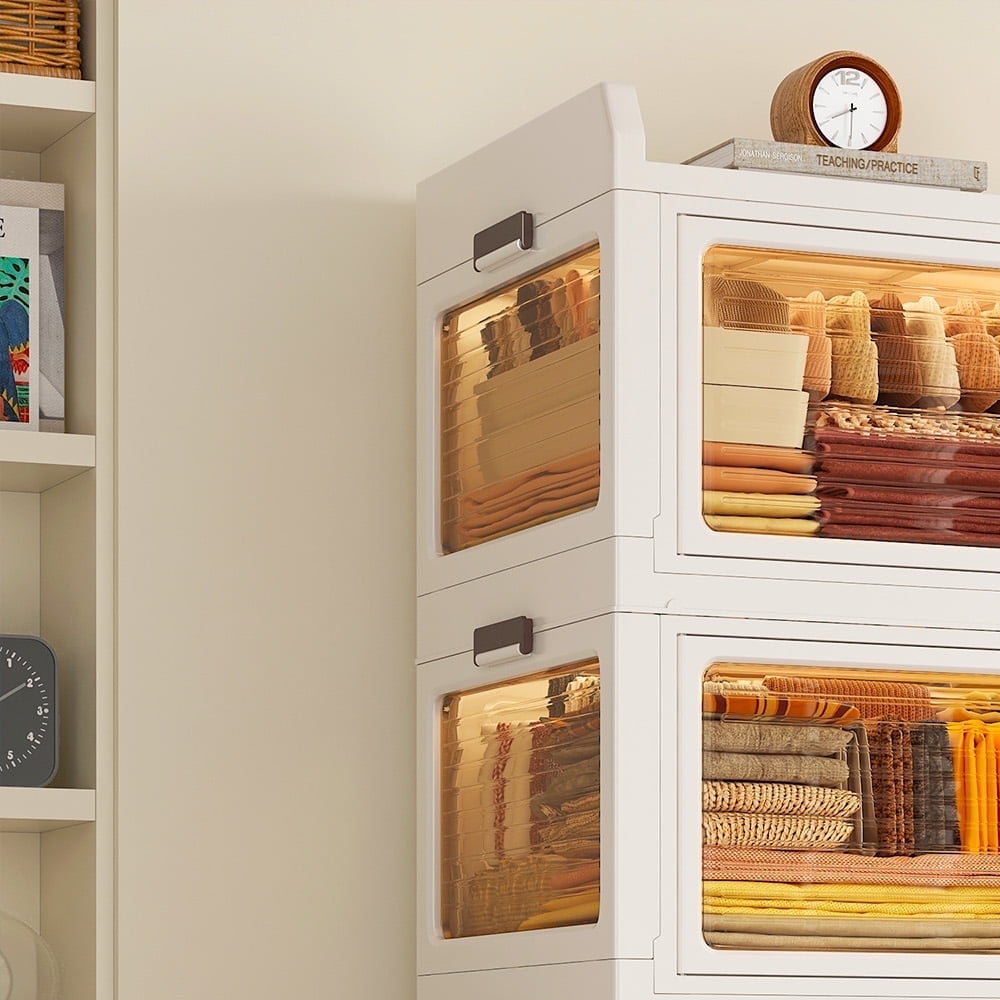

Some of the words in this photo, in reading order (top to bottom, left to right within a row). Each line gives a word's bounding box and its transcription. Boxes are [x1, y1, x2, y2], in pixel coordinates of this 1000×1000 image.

[835, 70, 861, 86] 12
[816, 154, 918, 175] TEACHING/PRACTICE
[6, 658, 12, 668] 1
[26, 679, 34, 688] 2
[36, 706, 43, 716] 3
[26, 732, 34, 742] 4
[7, 750, 14, 760] 5
